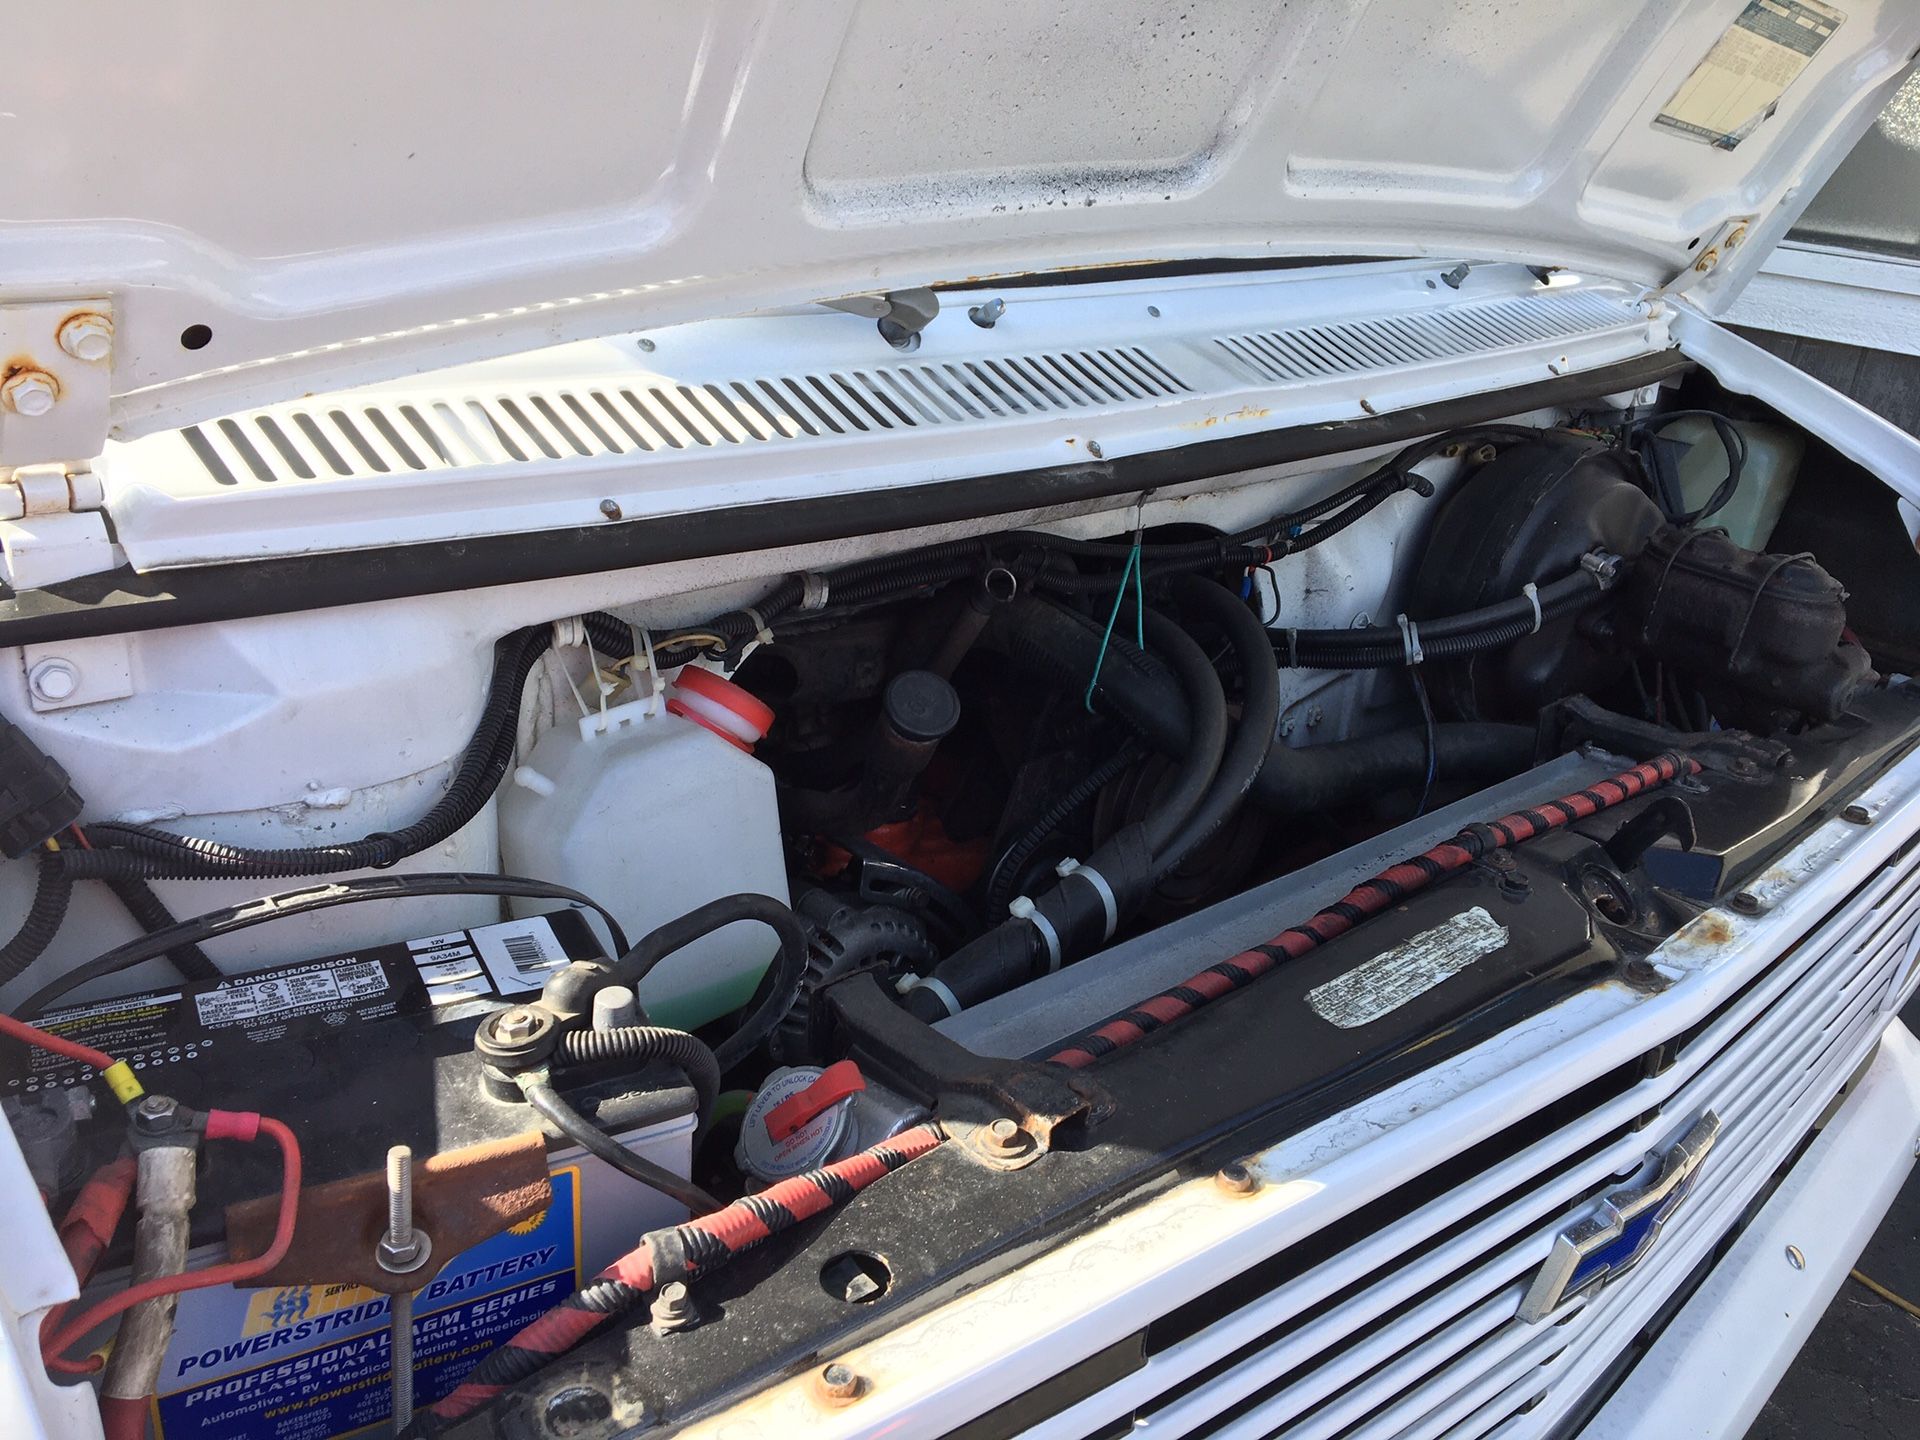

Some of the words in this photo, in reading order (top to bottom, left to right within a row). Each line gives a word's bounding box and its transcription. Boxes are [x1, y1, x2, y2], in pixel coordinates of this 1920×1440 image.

[430, 938, 445, 946] 12V
[430, 950, 461, 961] 9A34M
[234, 957, 357, 986] DANGER/POISON
[335, 966, 354, 974] FLUSH
[355, 971, 377, 980] WATER
[225, 987, 249, 995] SHIELD
[353, 987, 370, 995] HELP
[356, 979, 386, 989] MEDICAL
[43, 1006, 86, 1018] IMPORTANT
[92, 993, 155, 1008] NONSERVICEABLE
[201, 1008, 223, 1016] GASES
[208, 1021, 234, 1030] KEEP
[235, 1018, 255, 1026] OUT
[273, 1009, 290, 1018] THE
[292, 1003, 324, 1013] REACH
[340, 991, 385, 1004] CHILDREN
[60, 1011, 92, 1021] ATTEMPT
[259, 1017, 278, 1025] NOT
[281, 1011, 307, 1020] OPEN
[749, 1112, 758, 1128] LIFT
[755, 1091, 773, 1113] LEVER
[772, 1083, 781, 1093] TO
[781, 1075, 807, 1087] UNLOCK
[774, 1147, 792, 1162] OPEN
[792, 1136, 810, 1150] WHEN
[810, 1126, 823, 1138] HOT
[785, 1138, 795, 1148] DO
[795, 1129, 808, 1141] NOT
[427, 1245, 557, 1300] BATTERY
[185, 1333, 392, 1408] PROFESSIONAL
[471, 1279, 557, 1317] SERIES
[238, 1371, 313, 1402] GLASS
[321, 1353, 369, 1374] MAT
[377, 1308, 512, 1357] THNOLOGY
[201, 1395, 284, 1427] Automotive
[302, 1381, 320, 1396] RV
[339, 1360, 390, 1383] Medica
[412, 1340, 457, 1359] Marine
[263, 1339, 494, 1419] www.powerstridattery.com
